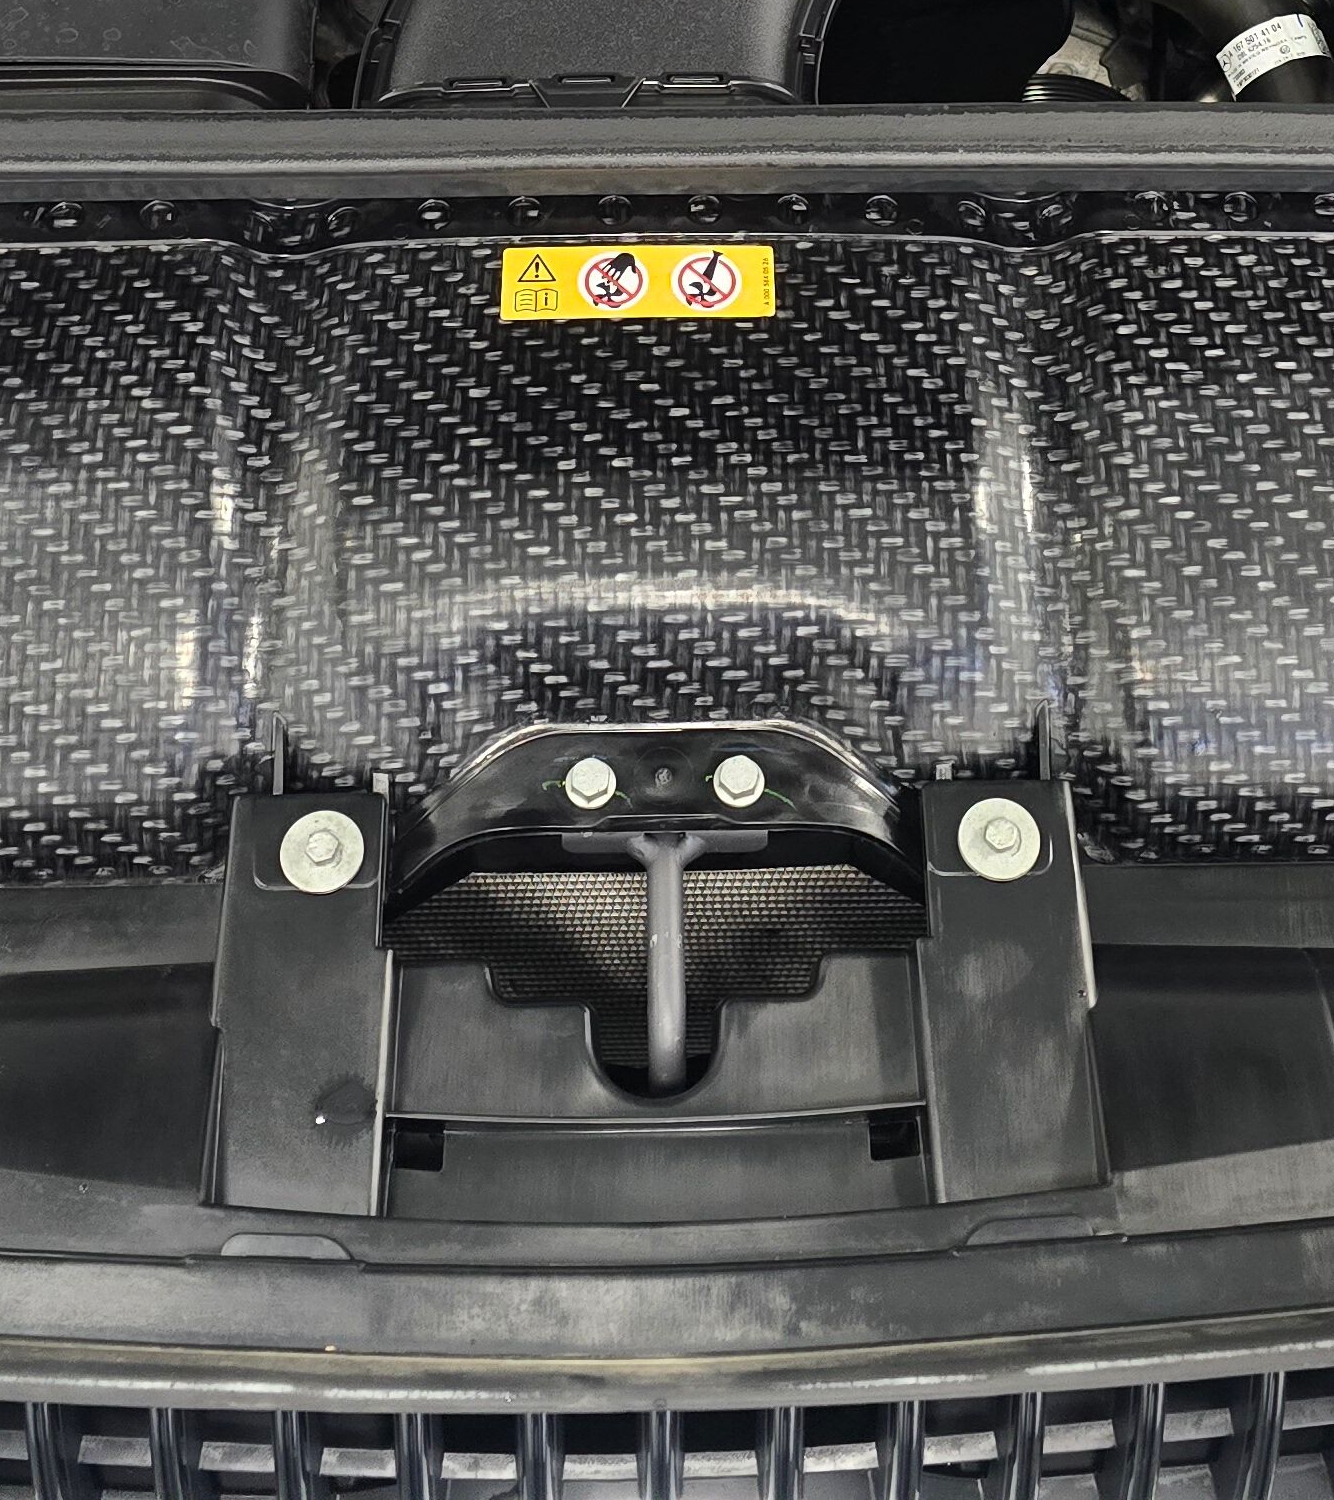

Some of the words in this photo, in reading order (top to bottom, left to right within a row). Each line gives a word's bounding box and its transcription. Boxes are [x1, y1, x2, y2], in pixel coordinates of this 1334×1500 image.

[1233, 41, 1244, 52] 167
[1245, 33, 1259, 45] 501
[1261, 28, 1270, 37] 41
[1271, 22, 1282, 33] 04
